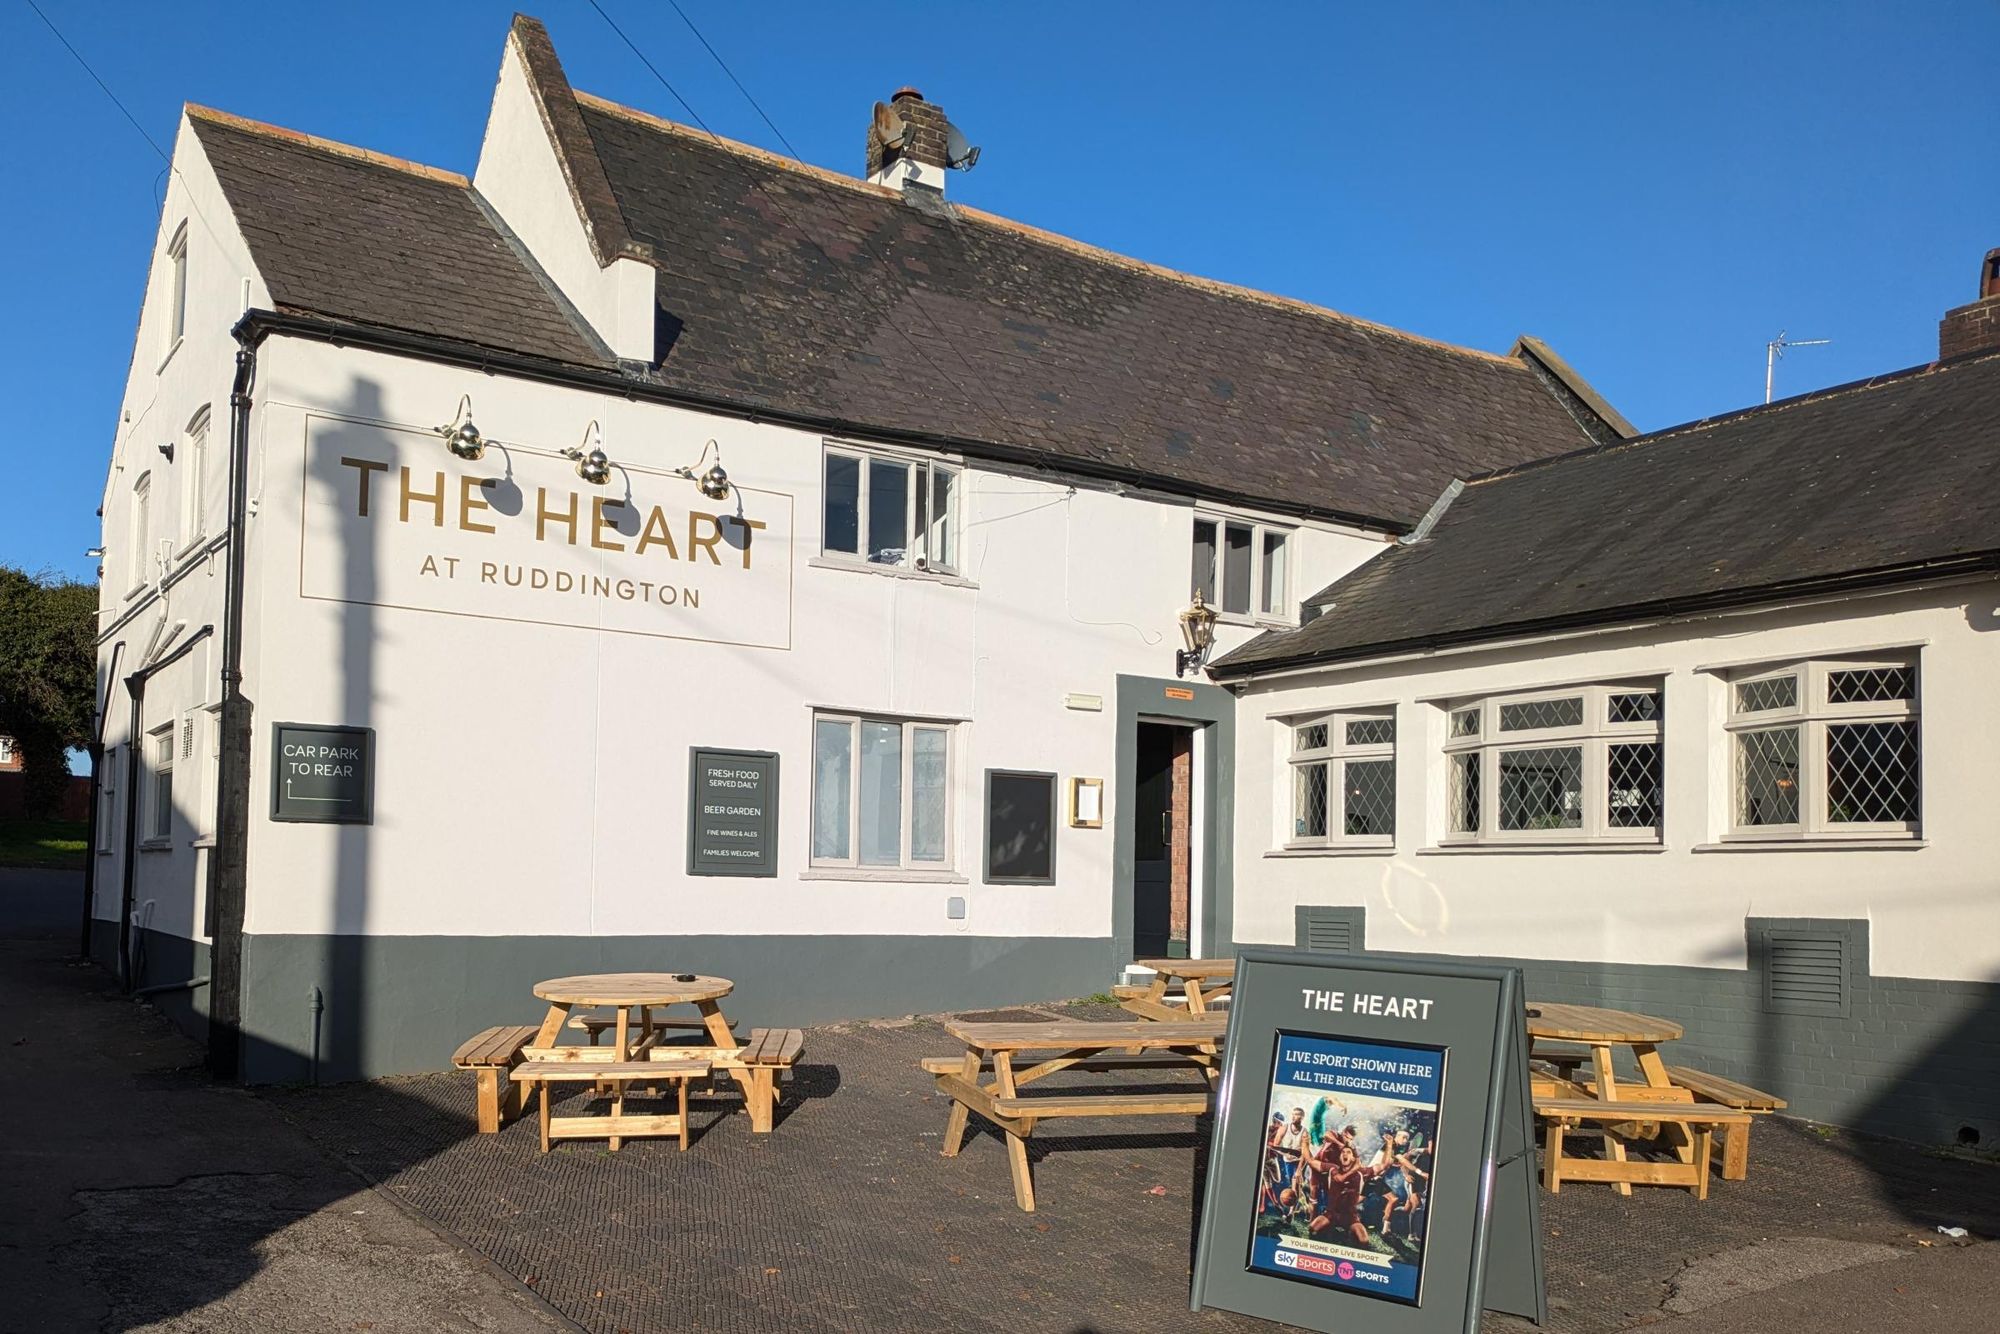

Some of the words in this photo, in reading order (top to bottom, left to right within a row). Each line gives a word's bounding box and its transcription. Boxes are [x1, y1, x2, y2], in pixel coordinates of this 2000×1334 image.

[341, 456, 496, 534] THE
[535, 487, 767, 569] HEART
[420, 555, 461, 579] AT
[482, 562, 700, 609] RUDDINGTON
[284, 745, 315, 758] CAR
[320, 747, 359, 760] PARK
[289, 763, 310, 774] TO
[315, 764, 352, 777] REAR
[708, 769, 734, 778] FRESH
[736, 770, 759, 780] FOOD
[709, 780, 736, 788] SERVED
[738, 781, 757, 789] DAILY
[704, 806, 725, 814] BEER
[727, 807, 760, 816] GARDEN
[1302, 989, 1344, 1012] THE
[1353, 994, 1433, 1020] HEART
[1286, 1050, 1311, 1064] LIVE
[1313, 1053, 1350, 1068] SPORT
[1351, 1058, 1396, 1073] SHOWN
[1399, 1063, 1432, 1078] HERE
[1293, 1070, 1312, 1082] ALL
[1314, 1073, 1334, 1085] THE
[1336, 1075, 1380, 1090] BIGGEST
[1381, 1081, 1419, 1095] GAMES
[1291, 1240, 1308, 1248] YOUR
[1310, 1243, 1329, 1252] HOME
[1341, 1250, 1355, 1258] LIVE
[1357, 1253, 1379, 1262] SPORT
[1277, 1252, 1295, 1265] sky
[1298, 1258, 1333, 1272] sports
[1340, 1267, 1353, 1275] TNT
[1355, 1270, 1389, 1284] SPORTS
